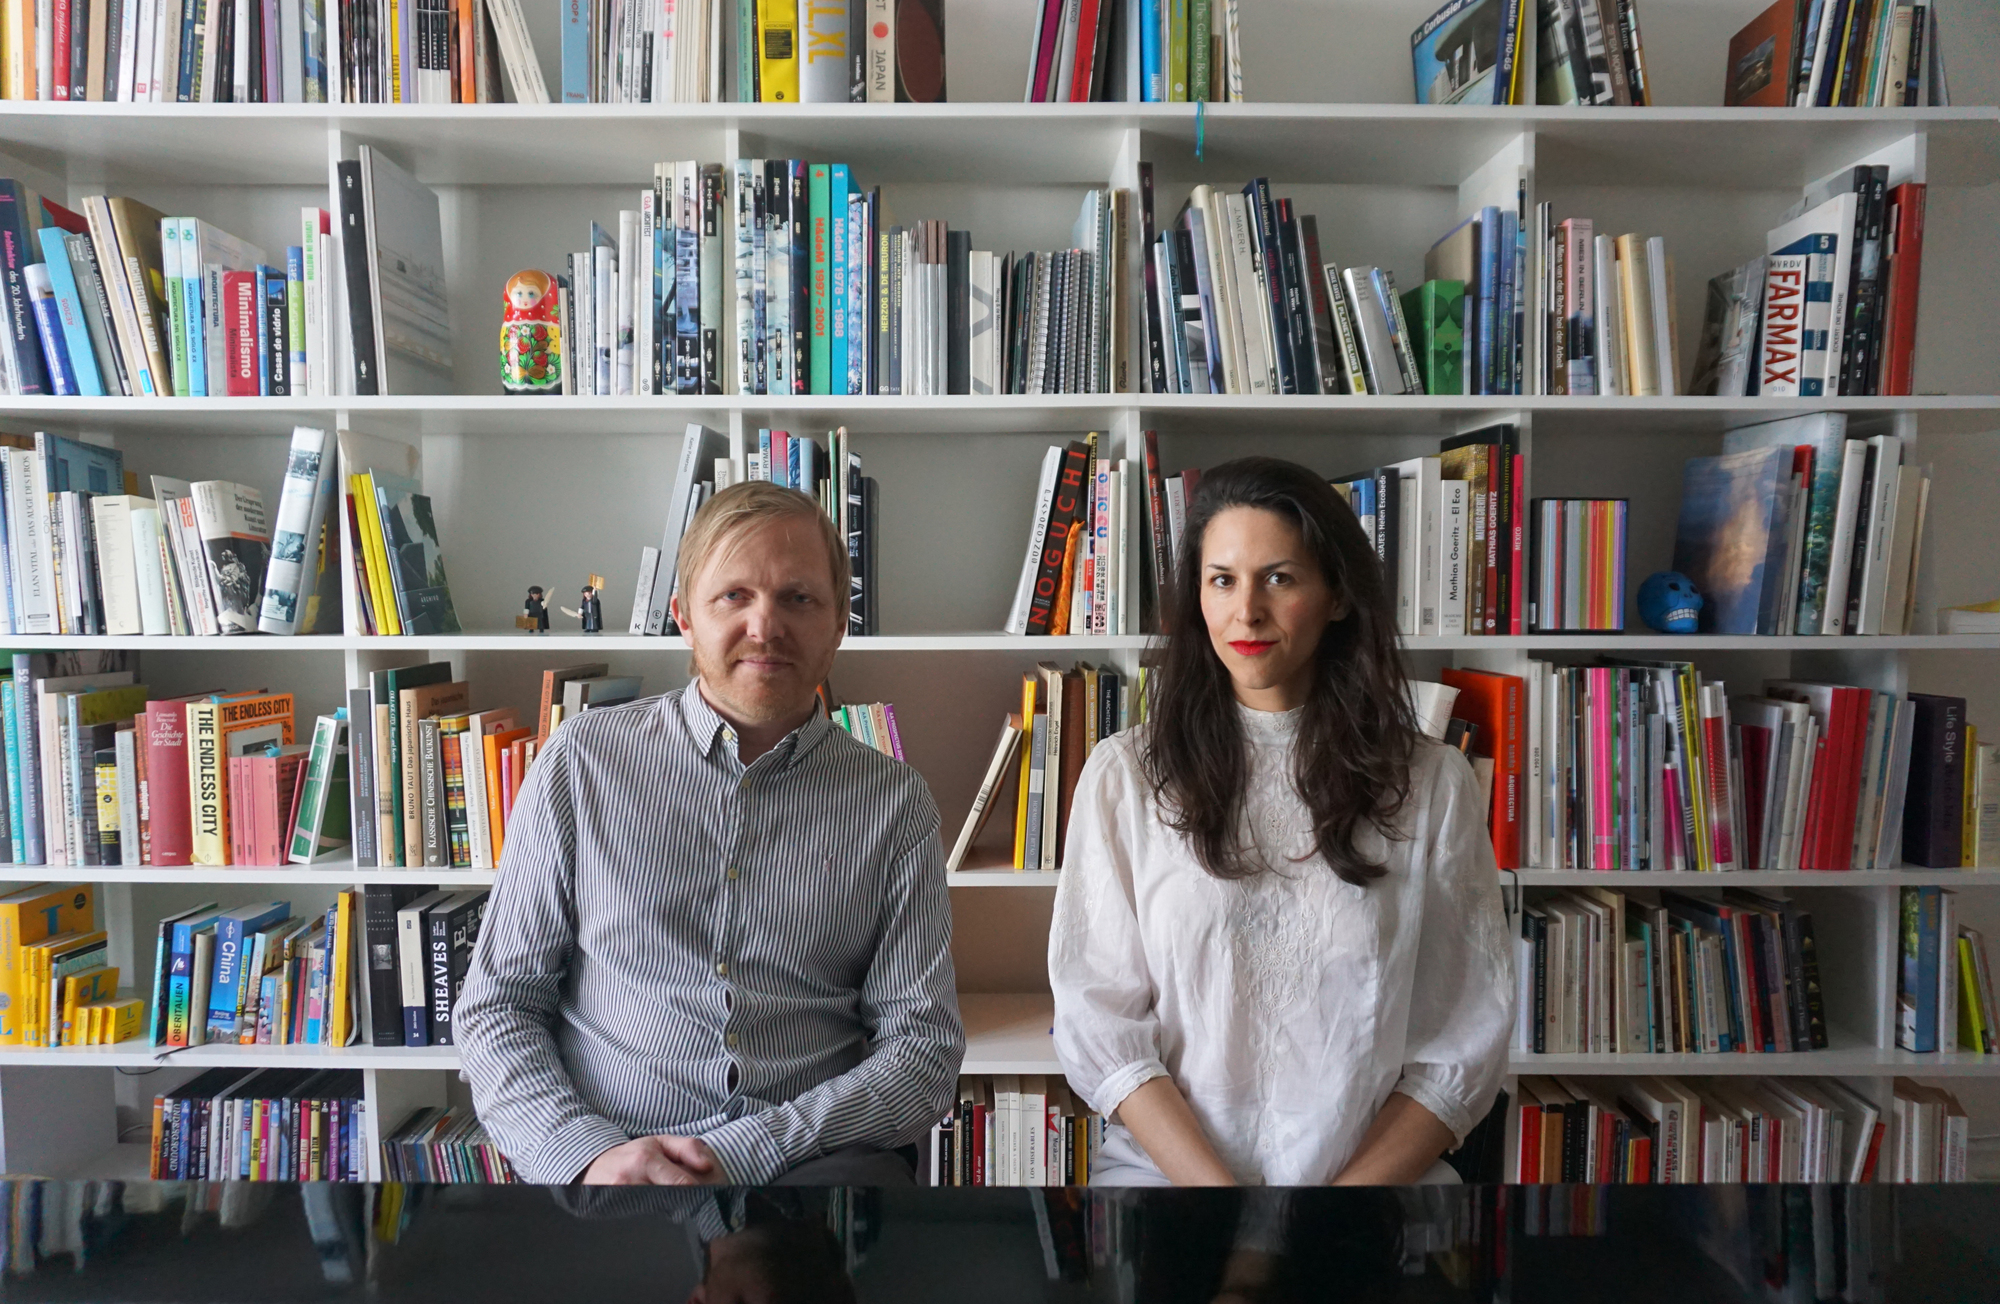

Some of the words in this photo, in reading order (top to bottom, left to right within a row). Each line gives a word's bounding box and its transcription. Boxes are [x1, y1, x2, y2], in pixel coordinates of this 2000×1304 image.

[1196, 1, 1207, 19] The
[1414, 32, 1423, 43] Le
[1424, 0, 1463, 33] Corbusier
[1196, 23, 1207, 59] Garden
[1620, 22, 1630, 49] Home
[1503, 32, 1515, 70] 1910-65
[393, 54, 401, 81] VERANO
[875, 50, 887, 90] JAPAN
[1195, 62, 1207, 88] Book
[1612, 55, 1624, 85] SIMON
[814, 169, 825, 178] 4
[644, 196, 652, 210] GA
[1259, 184, 1268, 205] Daniel
[305, 221, 314, 243] LIVING
[643, 211, 652, 237] ARCHITECT
[1235, 215, 1245, 245] MAYER
[1260, 206, 1271, 235] Libeskind
[3, 230, 15, 269] Architektur
[84, 237, 96, 260] Berlin
[306, 244, 314, 252] IN
[815, 217, 826, 263] H&deM
[834, 217, 845, 262] H&deM
[1239, 247, 1246, 255] H.
[1820, 235, 1829, 249] 5
[91, 262, 99, 270] in
[306, 253, 314, 281] MOTION
[1557, 244, 1566, 263] Mies
[1770, 259, 1802, 269] MVRDV
[9, 270, 19, 283] des
[834, 268, 845, 294] 1978
[881, 274, 888, 286] DE
[1170, 264, 1178, 285] Zaha
[1328, 269, 1338, 283] MIKE
[1578, 264, 1585, 274] IN
[94, 273, 110, 317] Architektur
[128, 257, 151, 315] ARCHITECTURE
[211, 270, 220, 328] ARQUITECTURA
[1331, 284, 1341, 300] DAVIS
[1557, 280, 1565, 294] der
[60, 297, 74, 326] AE2005
[1172, 288, 1181, 313] Hadid
[1557, 294, 1565, 315] Rohe
[13, 297, 26, 341] Jahrhunderts
[142, 316, 153, 324] IN
[171, 280, 179, 322] ARQUITECTURA
[176, 353, 182, 362] XX
[187, 282, 195, 323] ARQUITECTURA
[191, 355, 197, 363] XX
[238, 282, 255, 379] Minimalismo
[273, 308, 283, 336] vidrio
[834, 307, 845, 337] 1988
[1557, 316, 1565, 329] bei
[1764, 269, 1802, 385] FARMAX
[144, 325, 158, 352] JAPAN
[274, 338, 283, 350] de
[1337, 306, 1350, 338] PLANET
[1346, 343, 1359, 371] SLUMS
[1557, 330, 1565, 344] der
[229, 328, 237, 378] Minimalista
[1556, 345, 1565, 368] Arbeit
[273, 353, 283, 382] Casas
[1409, 362, 1419, 383] TOBIAS
[687, 437, 695, 450] Katie
[22, 455, 31, 478] EROS
[683, 450, 692, 473] Paterson
[24, 479, 32, 495] DES
[1379, 475, 1387, 508] Escobedo
[1451, 488, 1461, 504] Eco
[26, 495, 35, 519] AUGE
[1451, 506, 1460, 514] El
[1488, 490, 1497, 529] GOERITZ
[27, 520, 36, 537] DAS
[1029, 449, 1086, 625] NOGUCHI
[1475, 517, 1486, 541] MATHIAS
[1450, 526, 1460, 560] Goeritz
[1488, 530, 1497, 567] MATHIAS
[30, 549, 39, 573] VITAL
[188, 550, 196, 565] Kunst
[31, 574, 41, 597] ELAN
[1449, 563, 1459, 601] Mathias
[17, 668, 29, 683] 52
[198, 708, 215, 735] THE
[222, 706, 239, 722] THE
[239, 701, 272, 721] ENDLESS
[273, 697, 291, 714] CITY
[861, 711, 867, 719] AA
[875, 710, 881, 718] AA
[1946, 705, 1957, 728] Life
[151, 730, 184, 740] Geschichte
[160, 723, 173, 731] Die
[405, 719, 414, 755] japanische
[890, 719, 901, 749] PROSPECTUS
[152, 738, 163, 746] der
[163, 738, 183, 747] Stadt
[425, 724, 434, 760] BAUKUNST
[1035, 727, 1043, 758] CONCRETE
[1943, 732, 1957, 763] Style
[199, 739, 217, 801] ENDLESS
[475, 748, 484, 782] ESTÉTICAS
[425, 761, 435, 807] CHINESISCHE
[479, 784, 488, 836] INVESTIGACIONES
[1507, 774, 1516, 822] ARQUITECTURA
[201, 804, 218, 836] CITY
[427, 807, 437, 848] KLASSISCHE
[4, 917, 13, 960] Fremdsprache
[218, 941, 235, 984] China
[433, 941, 450, 1022] SHEAVES
[173, 982, 184, 1042] OBERITALIEN
[170, 1103, 182, 1171] UNDERGROUND
